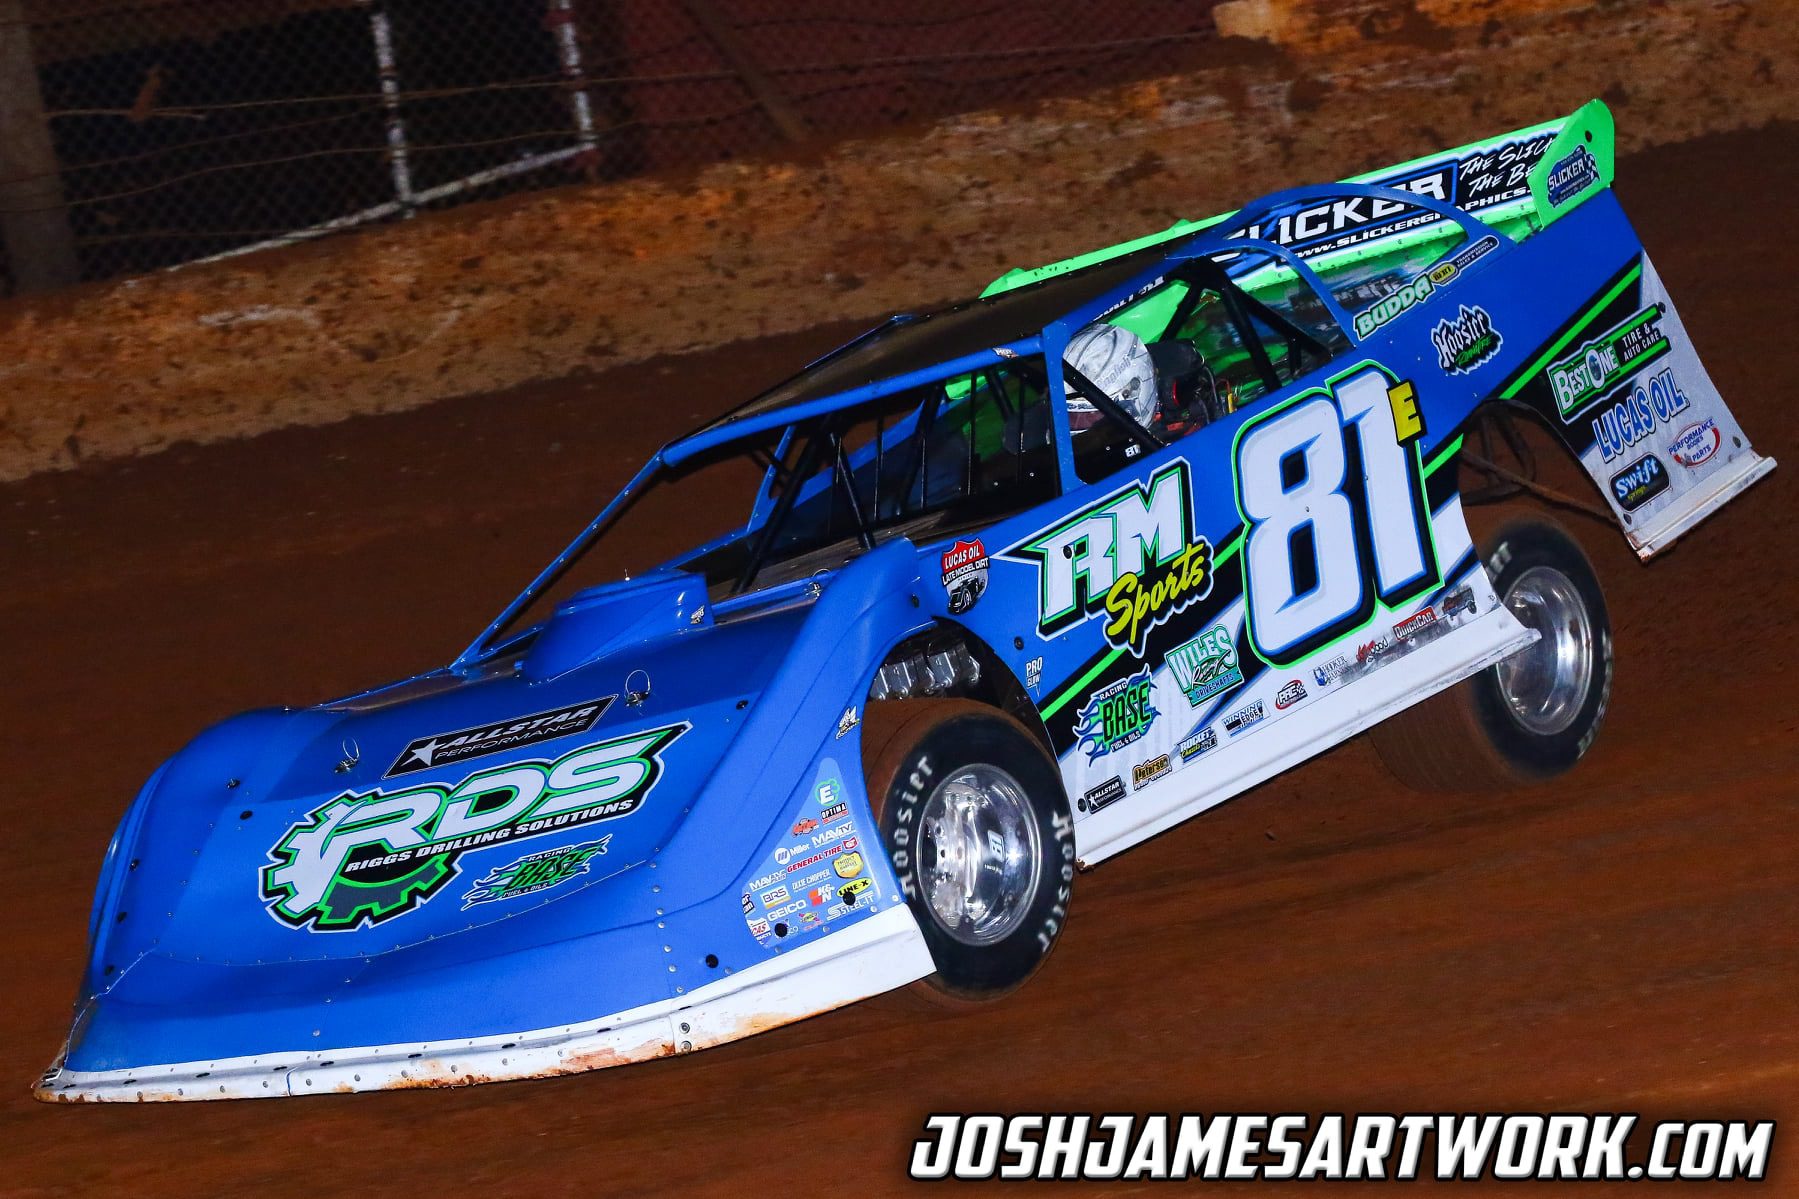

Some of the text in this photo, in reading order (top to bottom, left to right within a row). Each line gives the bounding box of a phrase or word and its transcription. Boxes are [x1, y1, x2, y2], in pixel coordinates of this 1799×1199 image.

[1459, 153, 1496, 181] THE
[1548, 158, 1585, 191] SLICKER
[1468, 171, 1505, 197] THE
[1356, 273, 1434, 337] BUDDA
[1436, 311, 1488, 369] Hoosier
[1622, 322, 1651, 348] TIRE &
[1623, 331, 1660, 361] AUTO CARE
[1592, 367, 1690, 462] LUCAS OIL
[1668, 419, 1715, 454] PERFORMANCE
[1692, 444, 1711, 462] PARTS
[1240, 370, 1427, 652] 81
[1387, 381, 1422, 442] E
[944, 545, 980, 570] LUCAS OIL
[1034, 473, 1184, 620] RM
[942, 557, 989, 586] LATE MODEL DIRT
[1107, 542, 1205, 645] Sports
[1026, 656, 1043, 677] PRO
[1167, 627, 1237, 690] WILES
[1100, 681, 1128, 700] RACING
[1195, 673, 1234, 699] DRIVESHAFTS
[442, 704, 600, 748] ALLSTAR
[1102, 682, 1151, 743] BASE
[1223, 700, 1263, 725] WINNING
[435, 720, 587, 760] PERFORMANCE
[1095, 781, 1120, 800] ALLSTAR
[272, 733, 664, 918] RDS
[821, 803, 847, 819] OPTIMA
[344, 799, 635, 873] RIGGS DRILLING SOLUTIONS
[811, 821, 853, 847] MAVTV
[528, 847, 571, 862] RACING
[787, 845, 843, 874] GENERAL TIRE
[789, 843, 810, 856] Miller
[504, 848, 601, 890] BASE
[838, 879, 869, 896] LINE-X
[767, 899, 807, 921] GEICO
